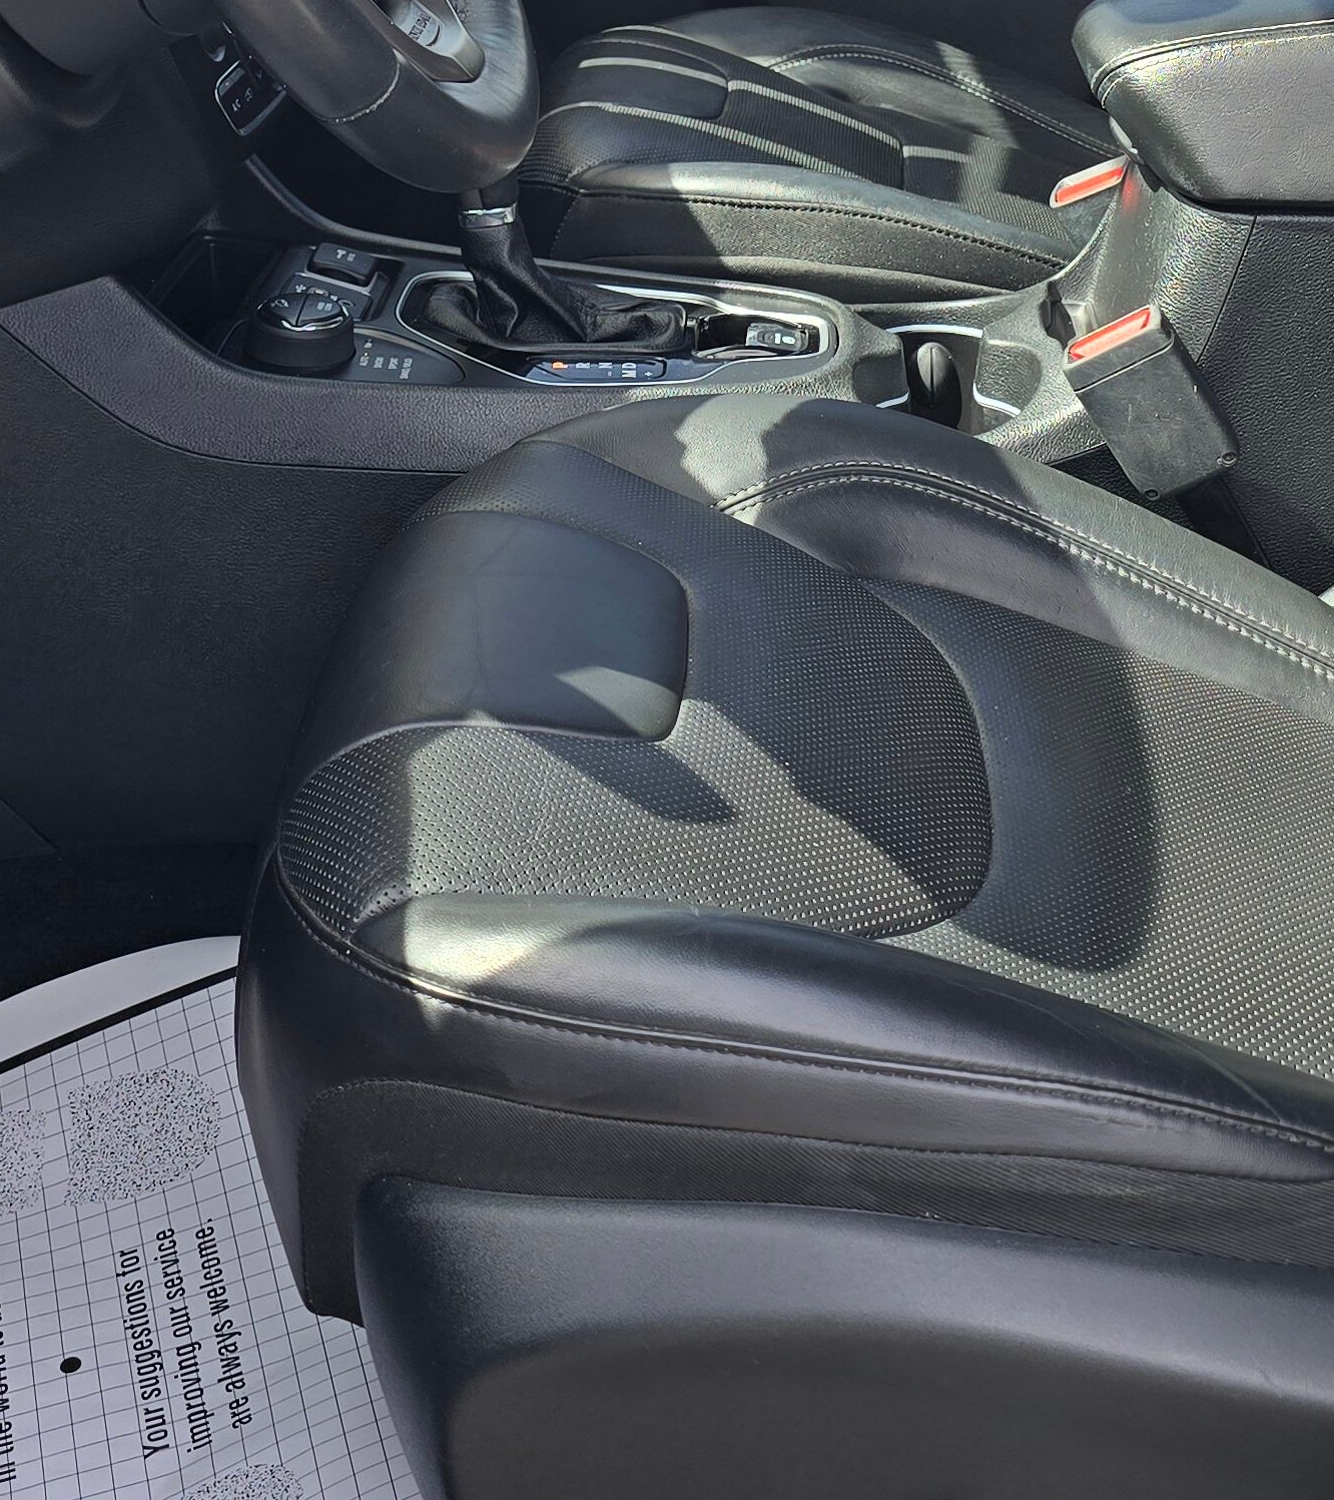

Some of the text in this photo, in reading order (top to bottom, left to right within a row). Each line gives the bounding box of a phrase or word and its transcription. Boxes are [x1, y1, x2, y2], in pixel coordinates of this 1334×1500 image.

[116, 1248, 170, 1460] Your suggestions for
[153, 1228, 215, 1453] improving our service
[195, 1218, 253, 1429] are always welcome.
